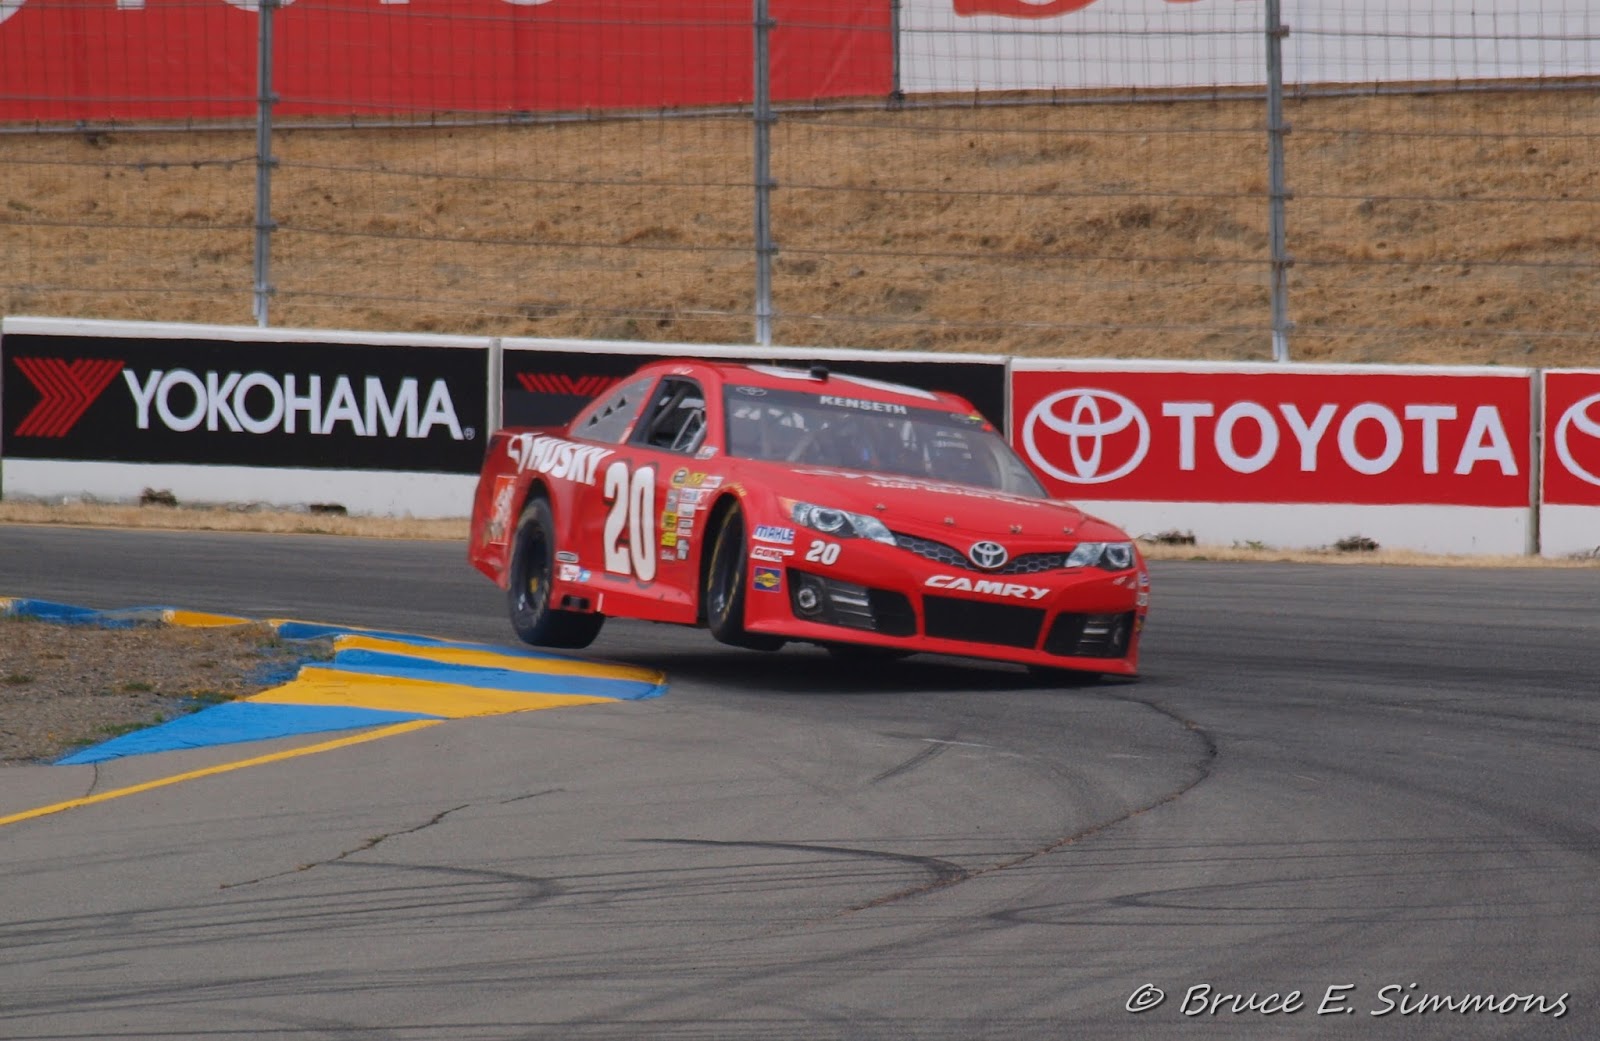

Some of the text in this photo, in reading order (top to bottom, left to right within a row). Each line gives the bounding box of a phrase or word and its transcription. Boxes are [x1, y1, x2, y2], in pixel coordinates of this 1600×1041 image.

[123, 368, 464, 440] YOKOHAMA
[819, 395, 907, 415] KENSETH
[1162, 402, 1518, 476] TOYOTA
[527, 435, 615, 486] HUSKY
[604, 461, 655, 582] 20
[754, 525, 795, 541] MAHLE
[805, 540, 841, 565] 20
[924, 575, 1051, 600] CAMRY
